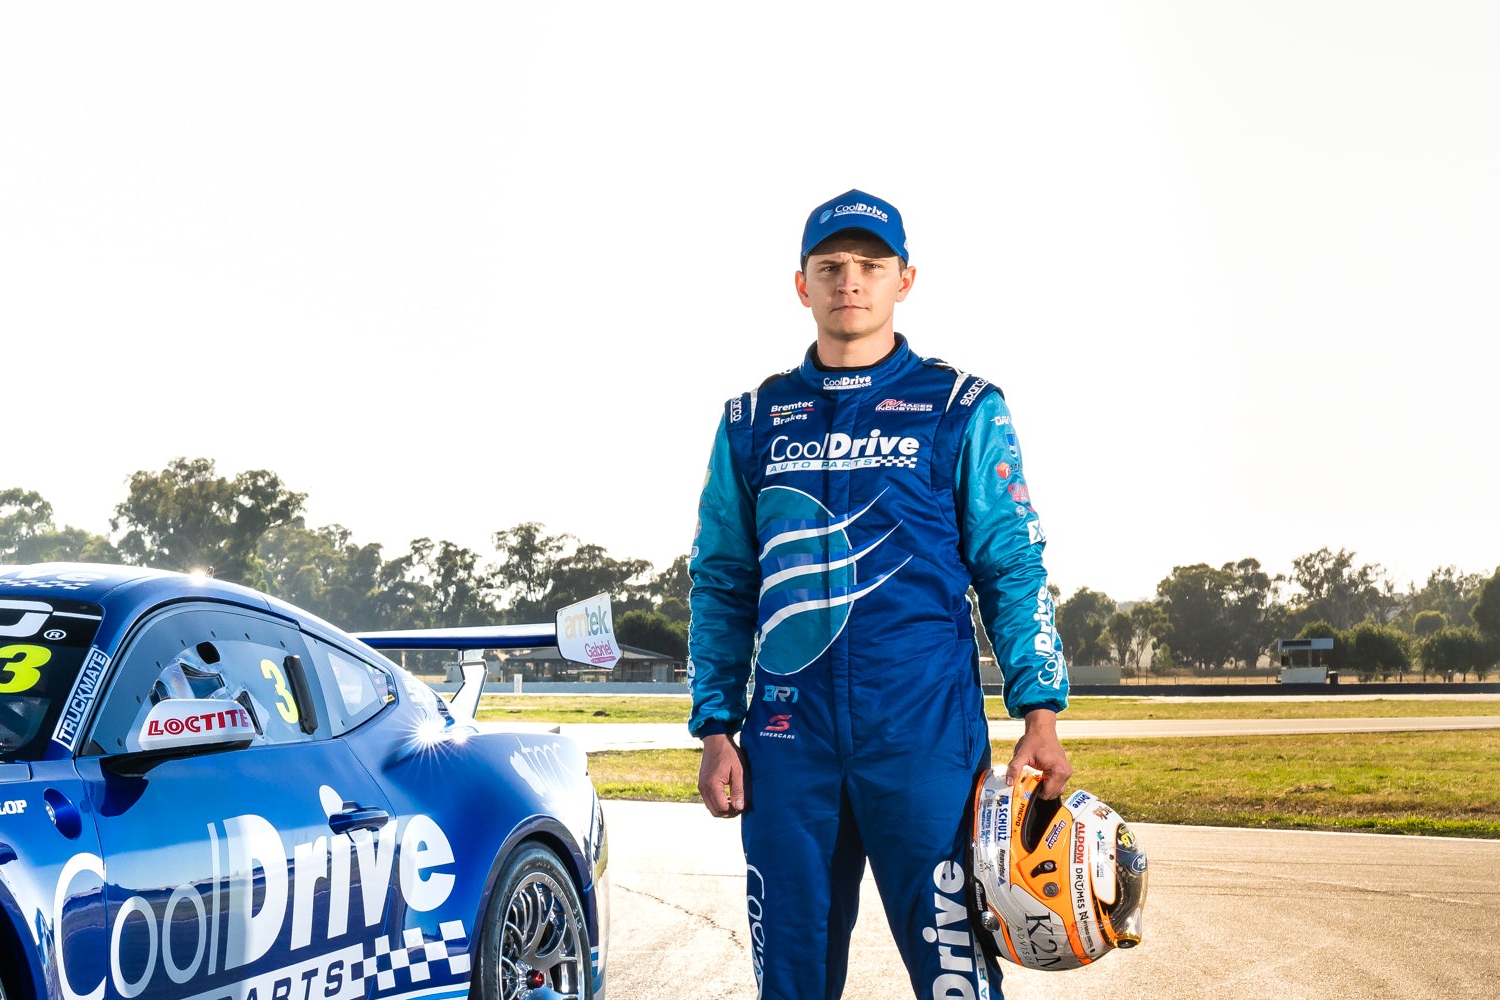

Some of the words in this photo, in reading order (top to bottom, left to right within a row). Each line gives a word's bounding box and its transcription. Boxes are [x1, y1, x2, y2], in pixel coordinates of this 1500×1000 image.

[835, 203, 888, 219] CoolDrive
[823, 375, 872, 387] CoolDrive
[732, 395, 742, 422] arco
[771, 401, 814, 412] Bremtec
[773, 413, 808, 426] Brakes
[770, 429, 919, 461] CoolDrive
[770, 462, 811, 472] AUTO
[821, 459, 872, 469] PARTS
[565, 605, 609, 640] amtek
[585, 640, 614, 658] Gabriel
[58, 653, 106, 747] TRUCKMATE
[260, 659, 299, 724] 3
[147, 709, 250, 736] LOCTITE
[760, 732, 795, 740] SUPERCARS
[1073, 793, 1091, 809] Drive
[998, 808, 1008, 841] SCHULZ
[1048, 820, 1067, 850] Border
[1076, 821, 1086, 865] ALDOM
